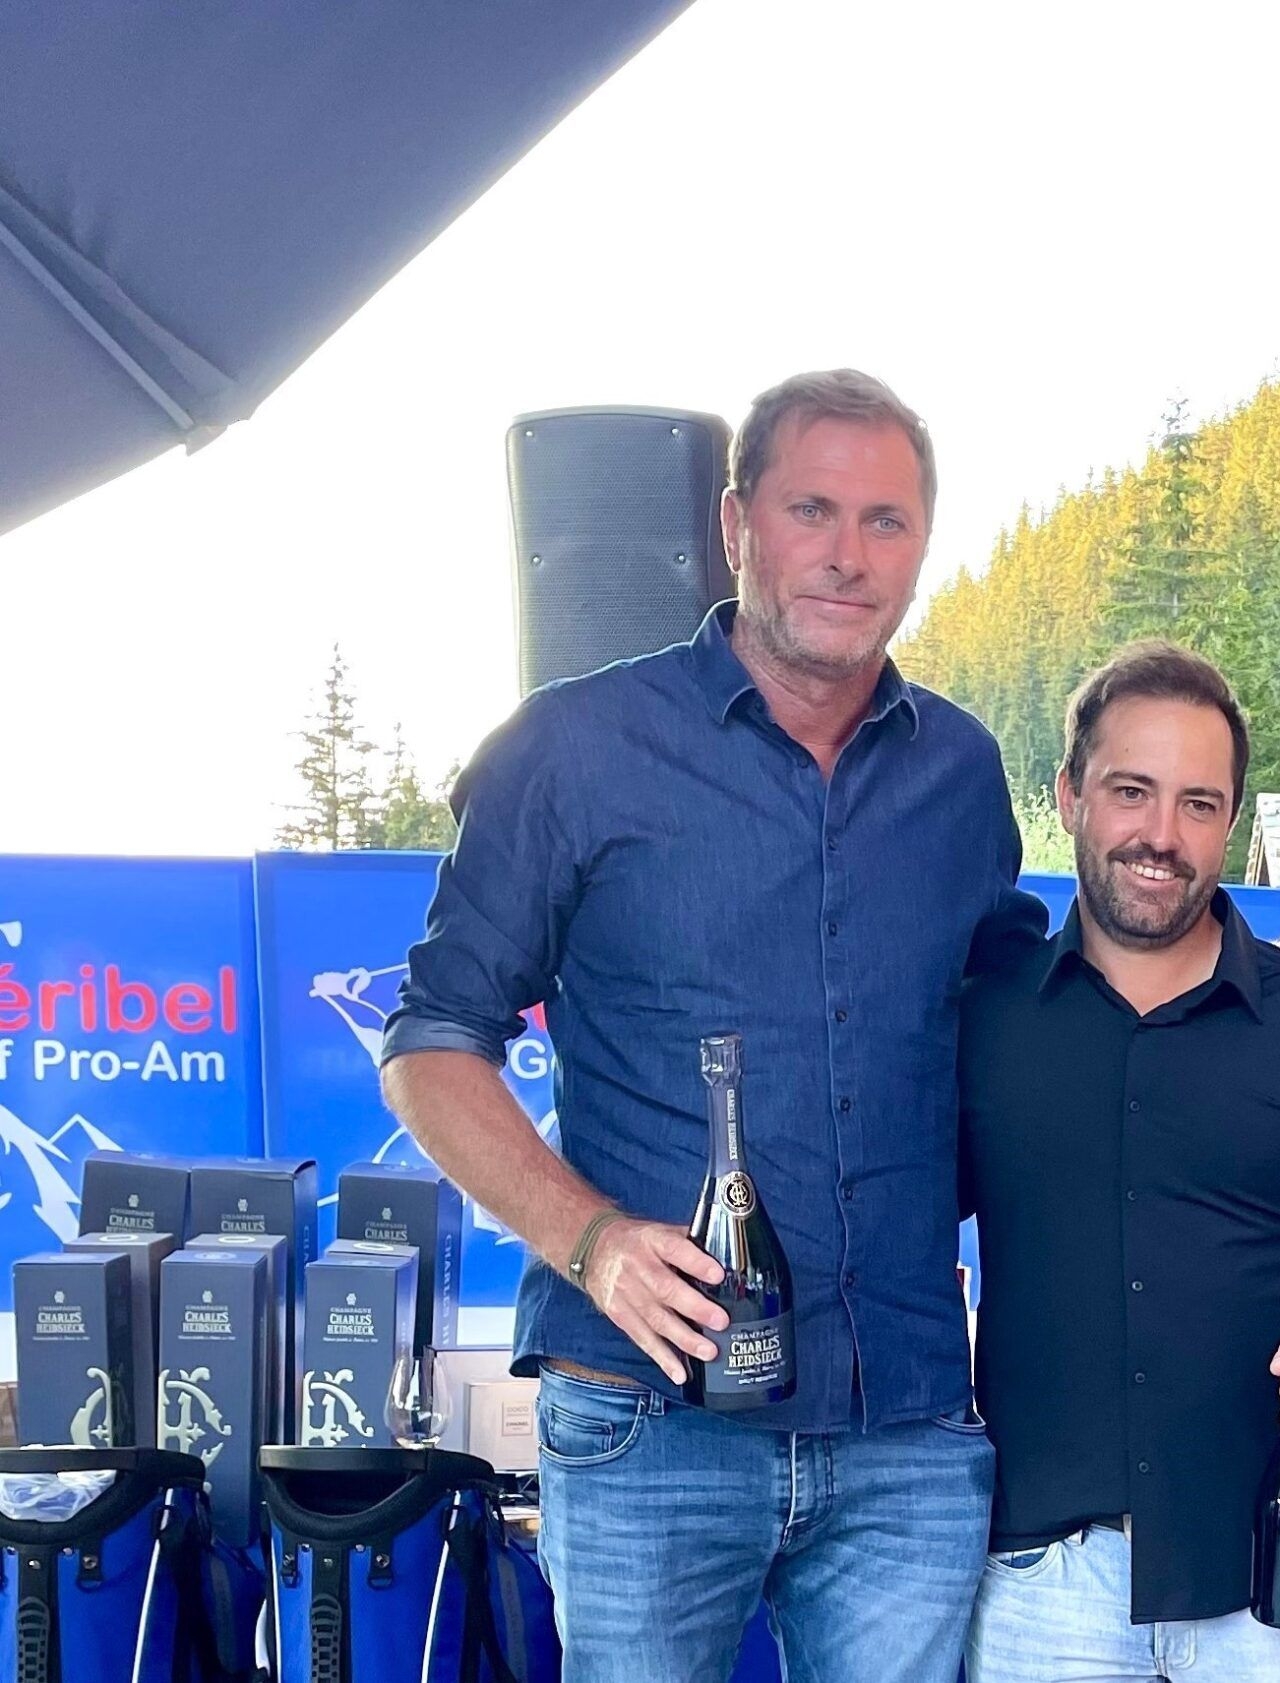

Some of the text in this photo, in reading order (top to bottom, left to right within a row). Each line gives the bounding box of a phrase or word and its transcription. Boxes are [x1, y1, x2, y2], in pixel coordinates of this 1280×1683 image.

[0, 963, 239, 1035] éribel
[33, 1039, 225, 1082] Pro-Am
[109, 1214, 154, 1229] CHARLES
[221, 1220, 265, 1233] CHARLES
[364, 1228, 408, 1241] CHARLES
[37, 1312, 82, 1323] CHARLES
[184, 1311, 229, 1323] CHARLES
[329, 1313, 372, 1325] CHARLES
[327, 1325, 375, 1336] HEIDSIECK
[731, 1335, 780, 1355] CHARLES
[728, 1347, 782, 1368] HEIDSIECK
